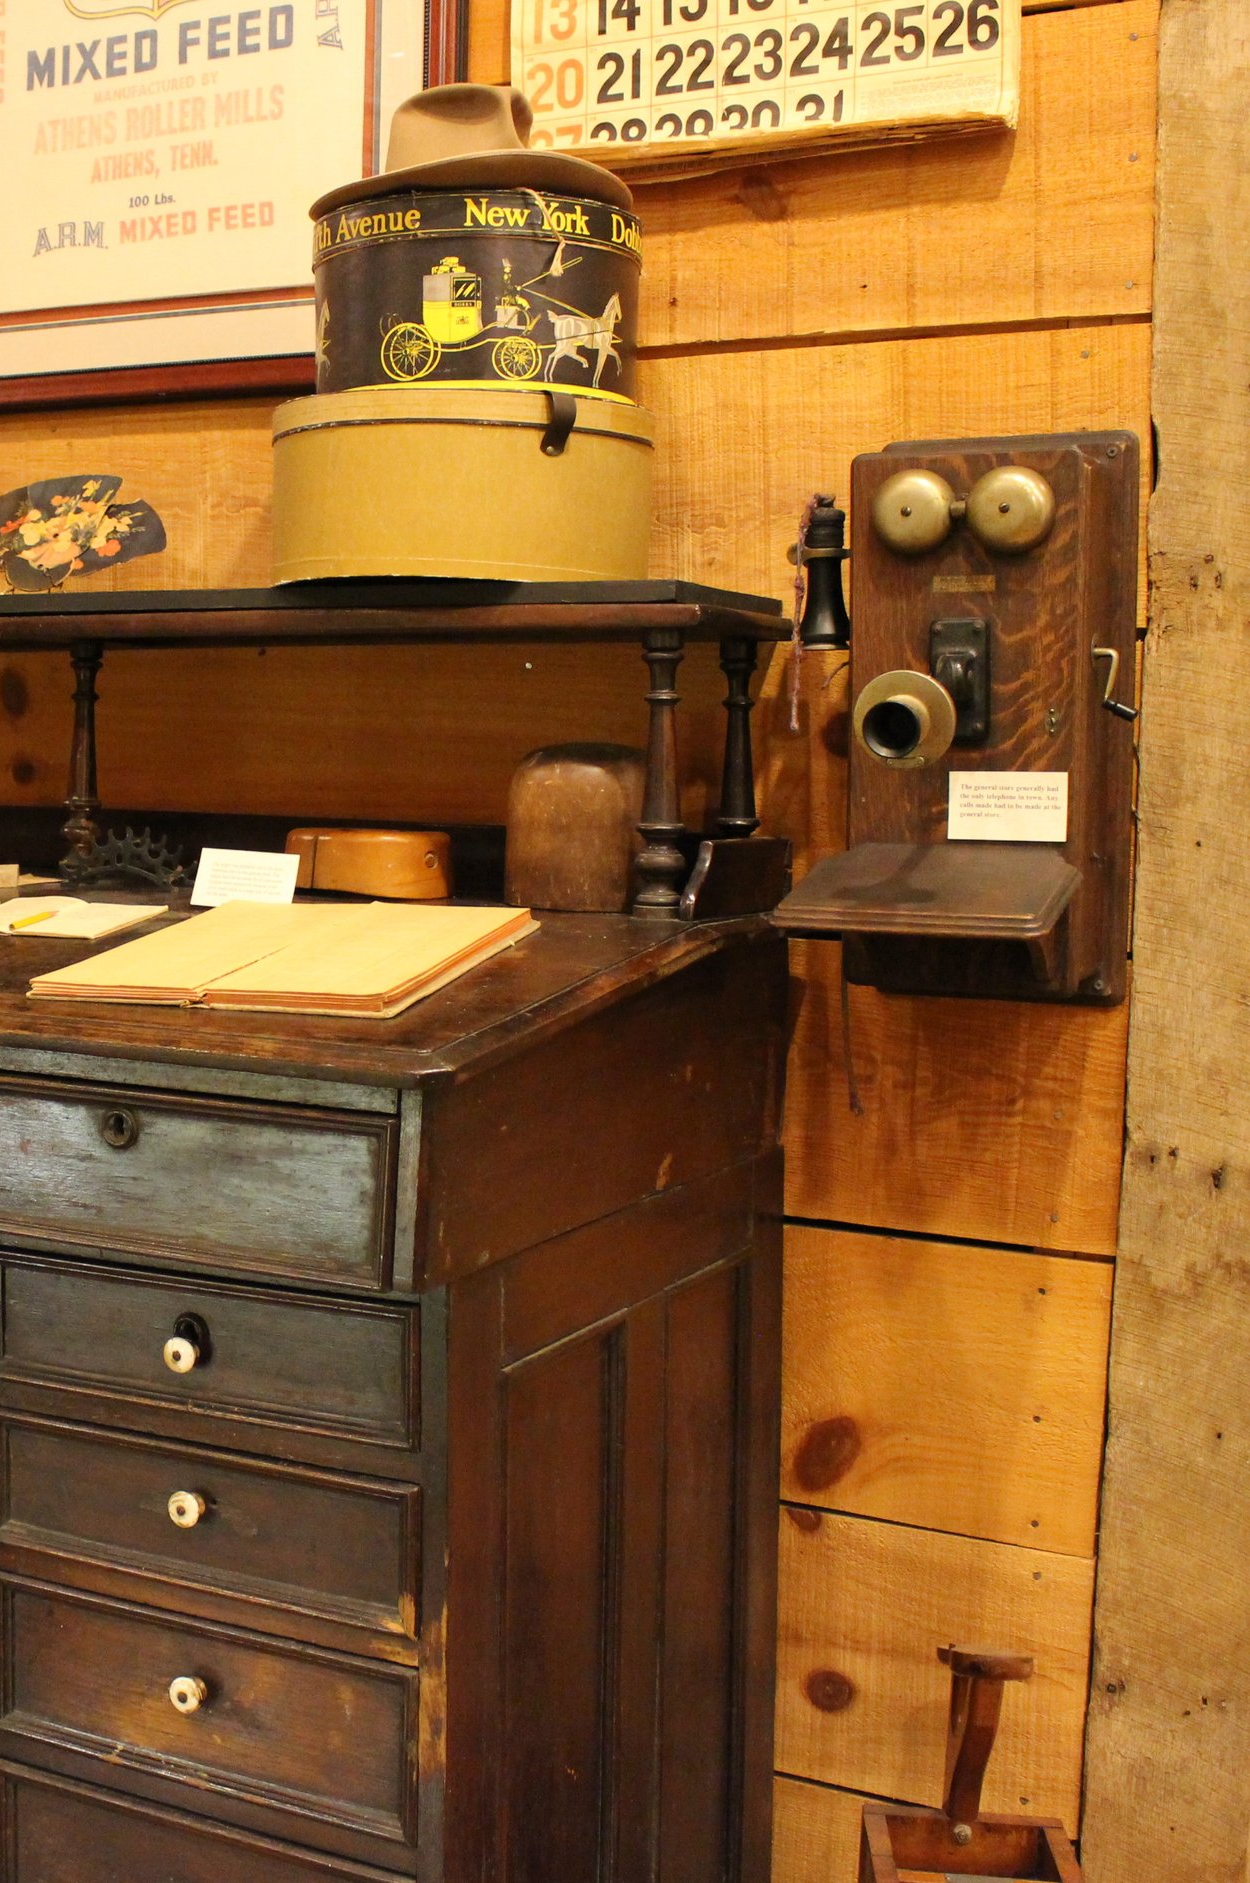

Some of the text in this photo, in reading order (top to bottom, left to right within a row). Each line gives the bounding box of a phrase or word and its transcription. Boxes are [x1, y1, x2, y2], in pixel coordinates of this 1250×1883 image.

[533, 0, 578, 45] 13
[26, 4, 294, 92] MIXED FEED
[526, 0, 1000, 114] 20 21 22 23 24 25 26
[92, 71, 219, 105] MANUFACTURED BY
[32, 83, 285, 156] ATHENS ROLLER MILLS
[91, 140, 220, 184] ATHENS, TENN.
[128, 193, 177, 209] 100 Lbs.
[335, 209, 422, 244] Avenue
[463, 198, 532, 228] New
[534, 201, 591, 236] York
[32, 200, 276, 258] A.R.M. MIXED FEED
[961, 783, 973, 791] The
[1016, 785, 1045, 793] generally
[987, 793, 1017, 801] telephone
